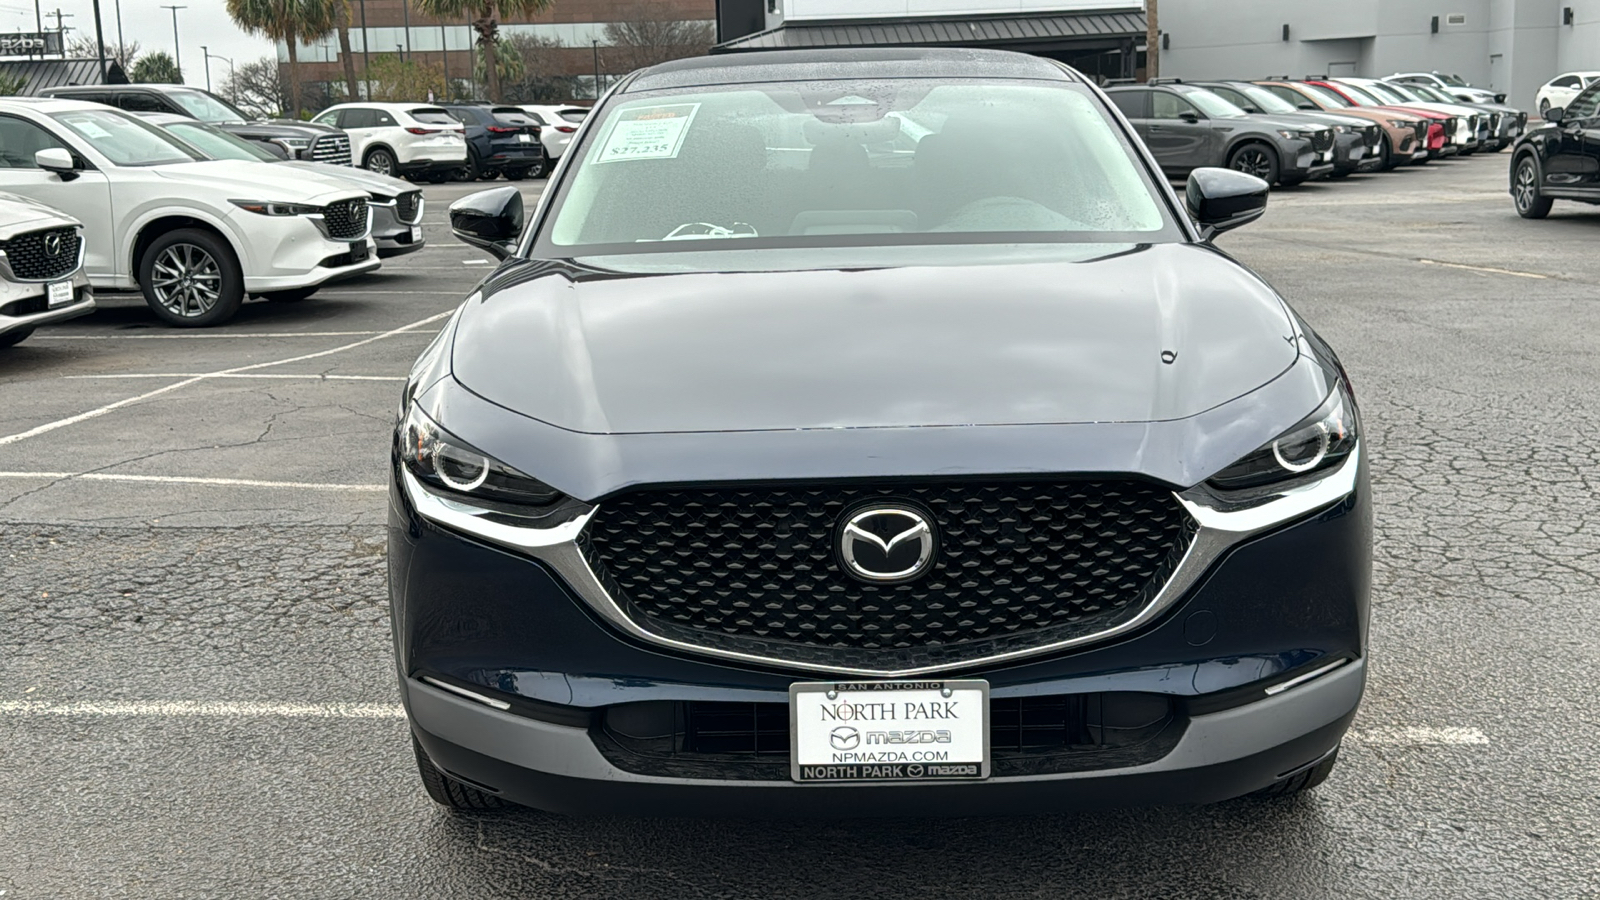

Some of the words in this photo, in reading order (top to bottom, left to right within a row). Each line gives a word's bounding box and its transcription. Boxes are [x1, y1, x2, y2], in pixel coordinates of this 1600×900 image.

[838, 683, 867, 691] SAN
[873, 682, 941, 690] ANTONIO
[820, 701, 895, 721] NORTH
[904, 701, 959, 720] PARK
[832, 751, 948, 762] NPMAZDA.COM
[804, 765, 857, 779] NORTH
[862, 764, 903, 777] PARK
